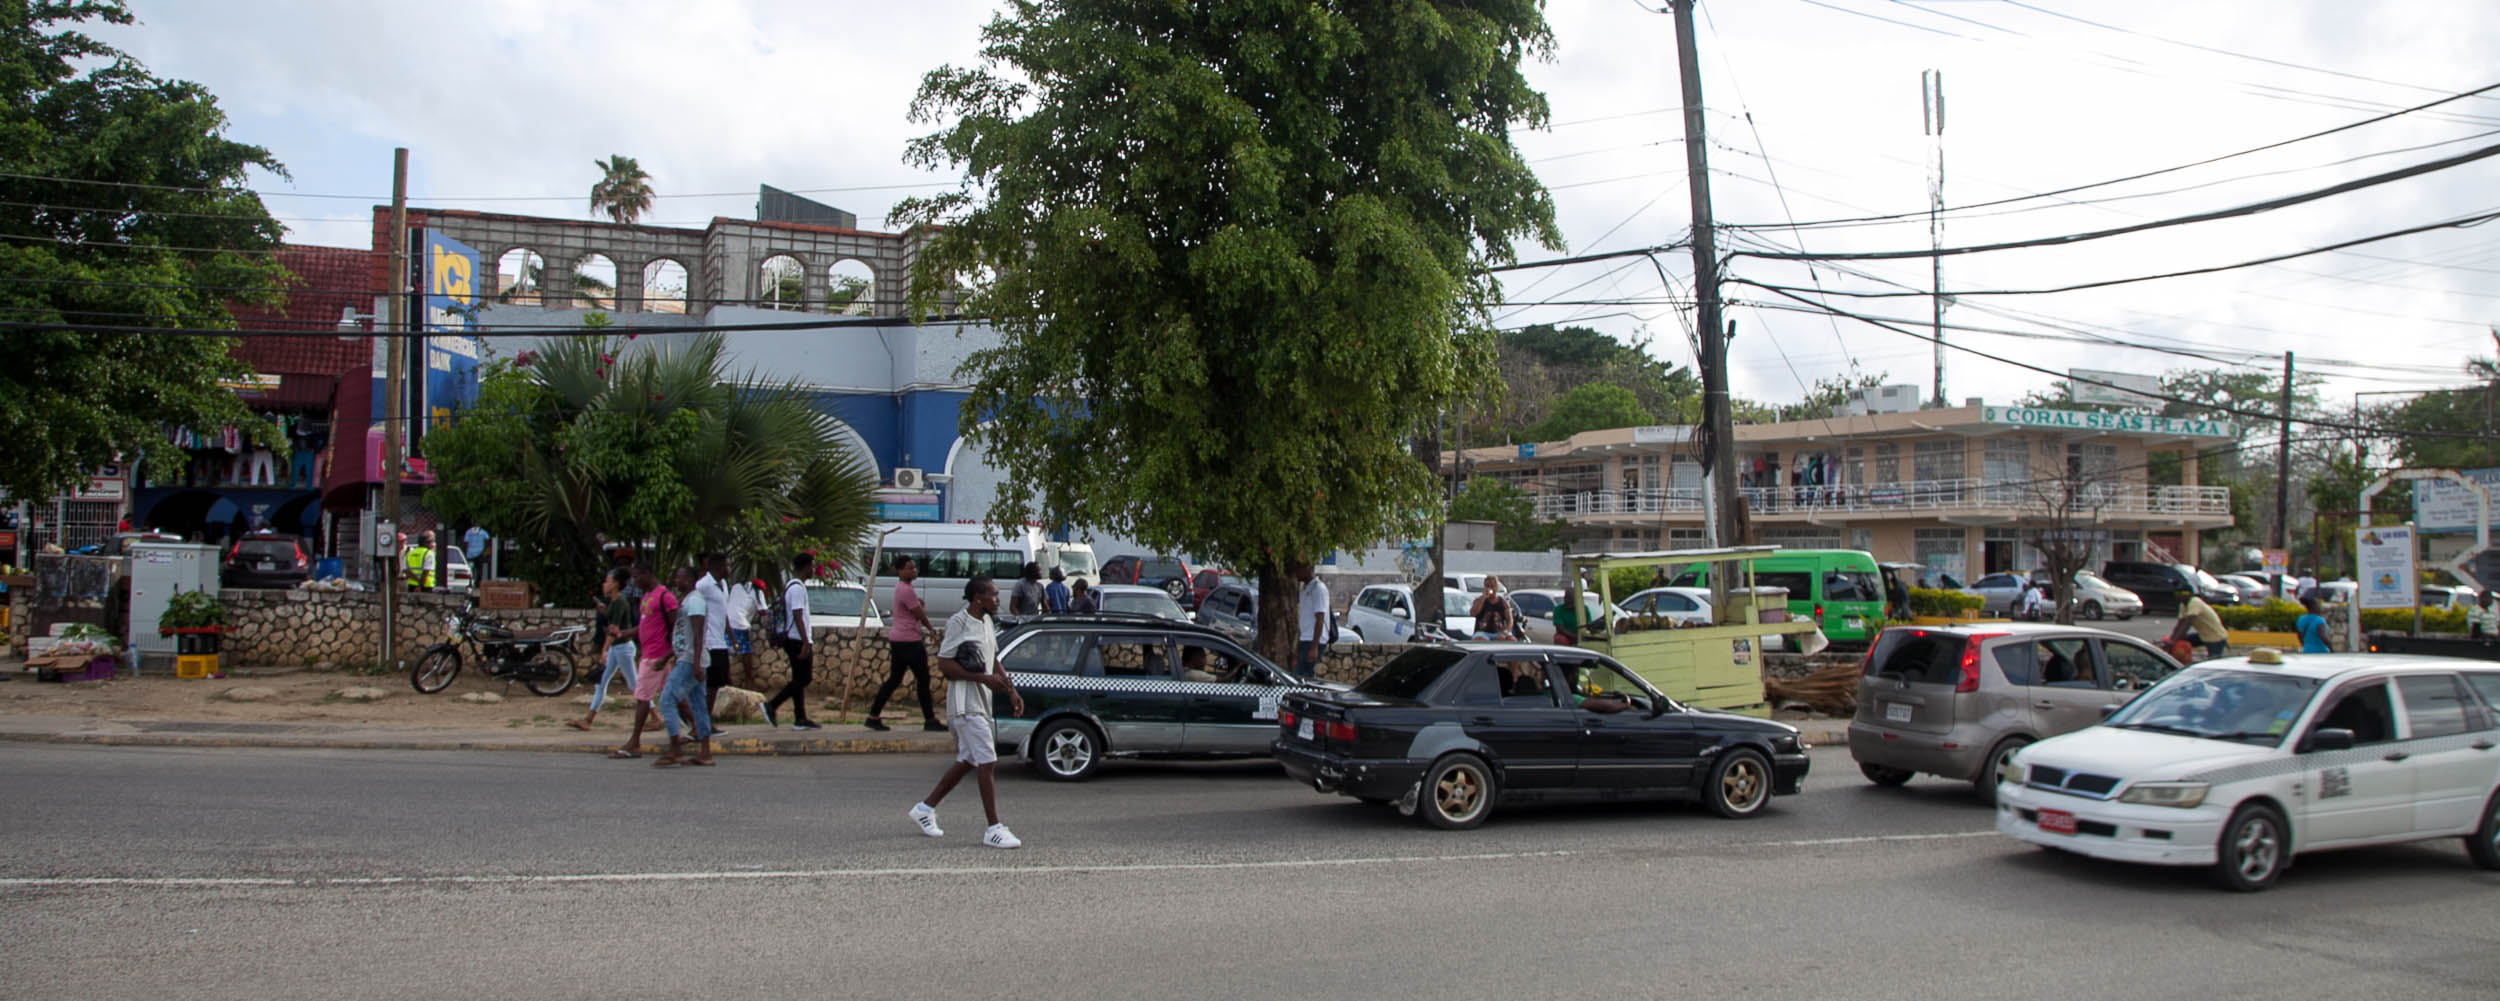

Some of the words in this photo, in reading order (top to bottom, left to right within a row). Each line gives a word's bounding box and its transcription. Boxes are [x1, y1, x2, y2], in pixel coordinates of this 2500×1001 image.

[433, 243, 471, 305] NCB
[2006, 408, 2079, 427] CORAL
[2086, 413, 2144, 431] SEAS
[2151, 418, 2220, 436] PLAZA
